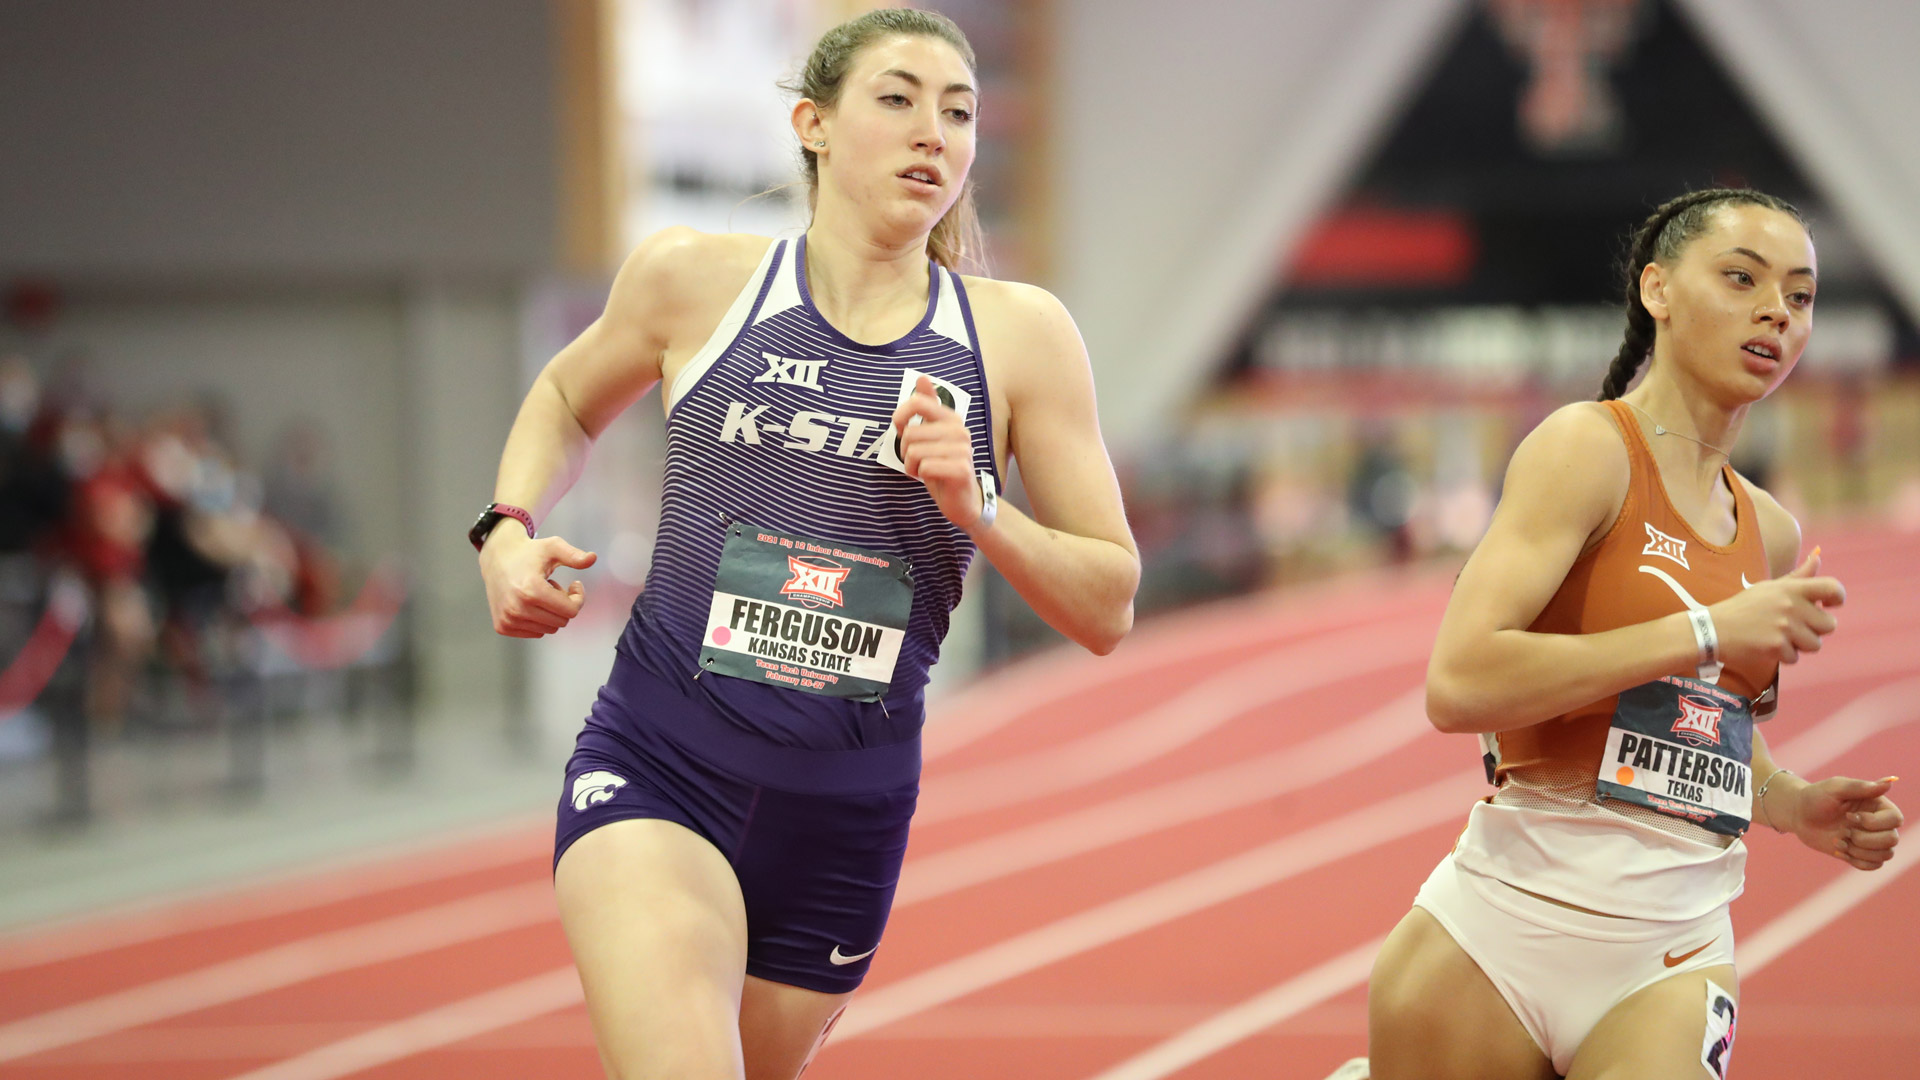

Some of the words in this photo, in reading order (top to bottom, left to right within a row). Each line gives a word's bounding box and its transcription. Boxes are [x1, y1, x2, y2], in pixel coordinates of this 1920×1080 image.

[752, 351, 829, 393] XII
[757, 533, 778, 545] 2021
[779, 538, 793, 549] Big
[795, 541, 806, 550] 12
[806, 543, 832, 555] Indoor
[833, 548, 890, 568] Championships
[1642, 523, 1689, 570] XII
[783, 559, 848, 603] XII
[730, 598, 883, 658] FERGUSON
[748, 637, 808, 664] KANSAS
[810, 650, 852, 673] STATE
[756, 659, 779, 671] Texas
[780, 664, 800, 675] Tech
[801, 668, 839, 684] University
[765, 671, 800, 686] February
[801, 678, 825, 690] 26-27
[1673, 698, 1721, 741] XII
[1617, 733, 1746, 797] PATTERSON
[1667, 779, 1704, 803] TEXAS
[1707, 995, 1735, 1080] 2
